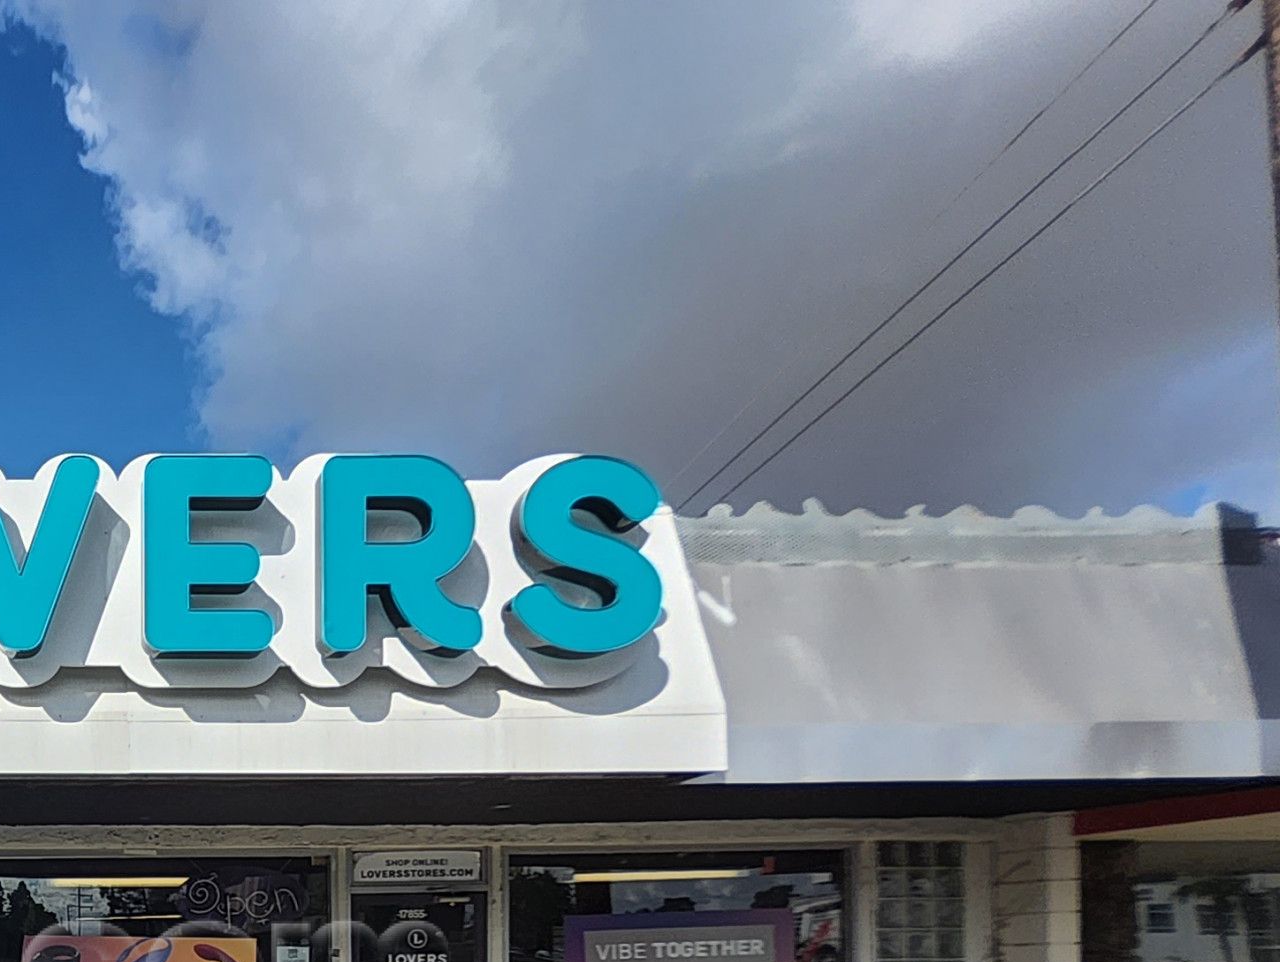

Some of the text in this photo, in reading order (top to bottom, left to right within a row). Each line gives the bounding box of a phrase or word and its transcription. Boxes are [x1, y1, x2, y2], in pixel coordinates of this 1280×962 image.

[385, 858, 410, 867] SHOP
[360, 868, 474, 879] LOVERSSTORES.COM
[595, 939, 765, 961] VIBE TOGETHER
